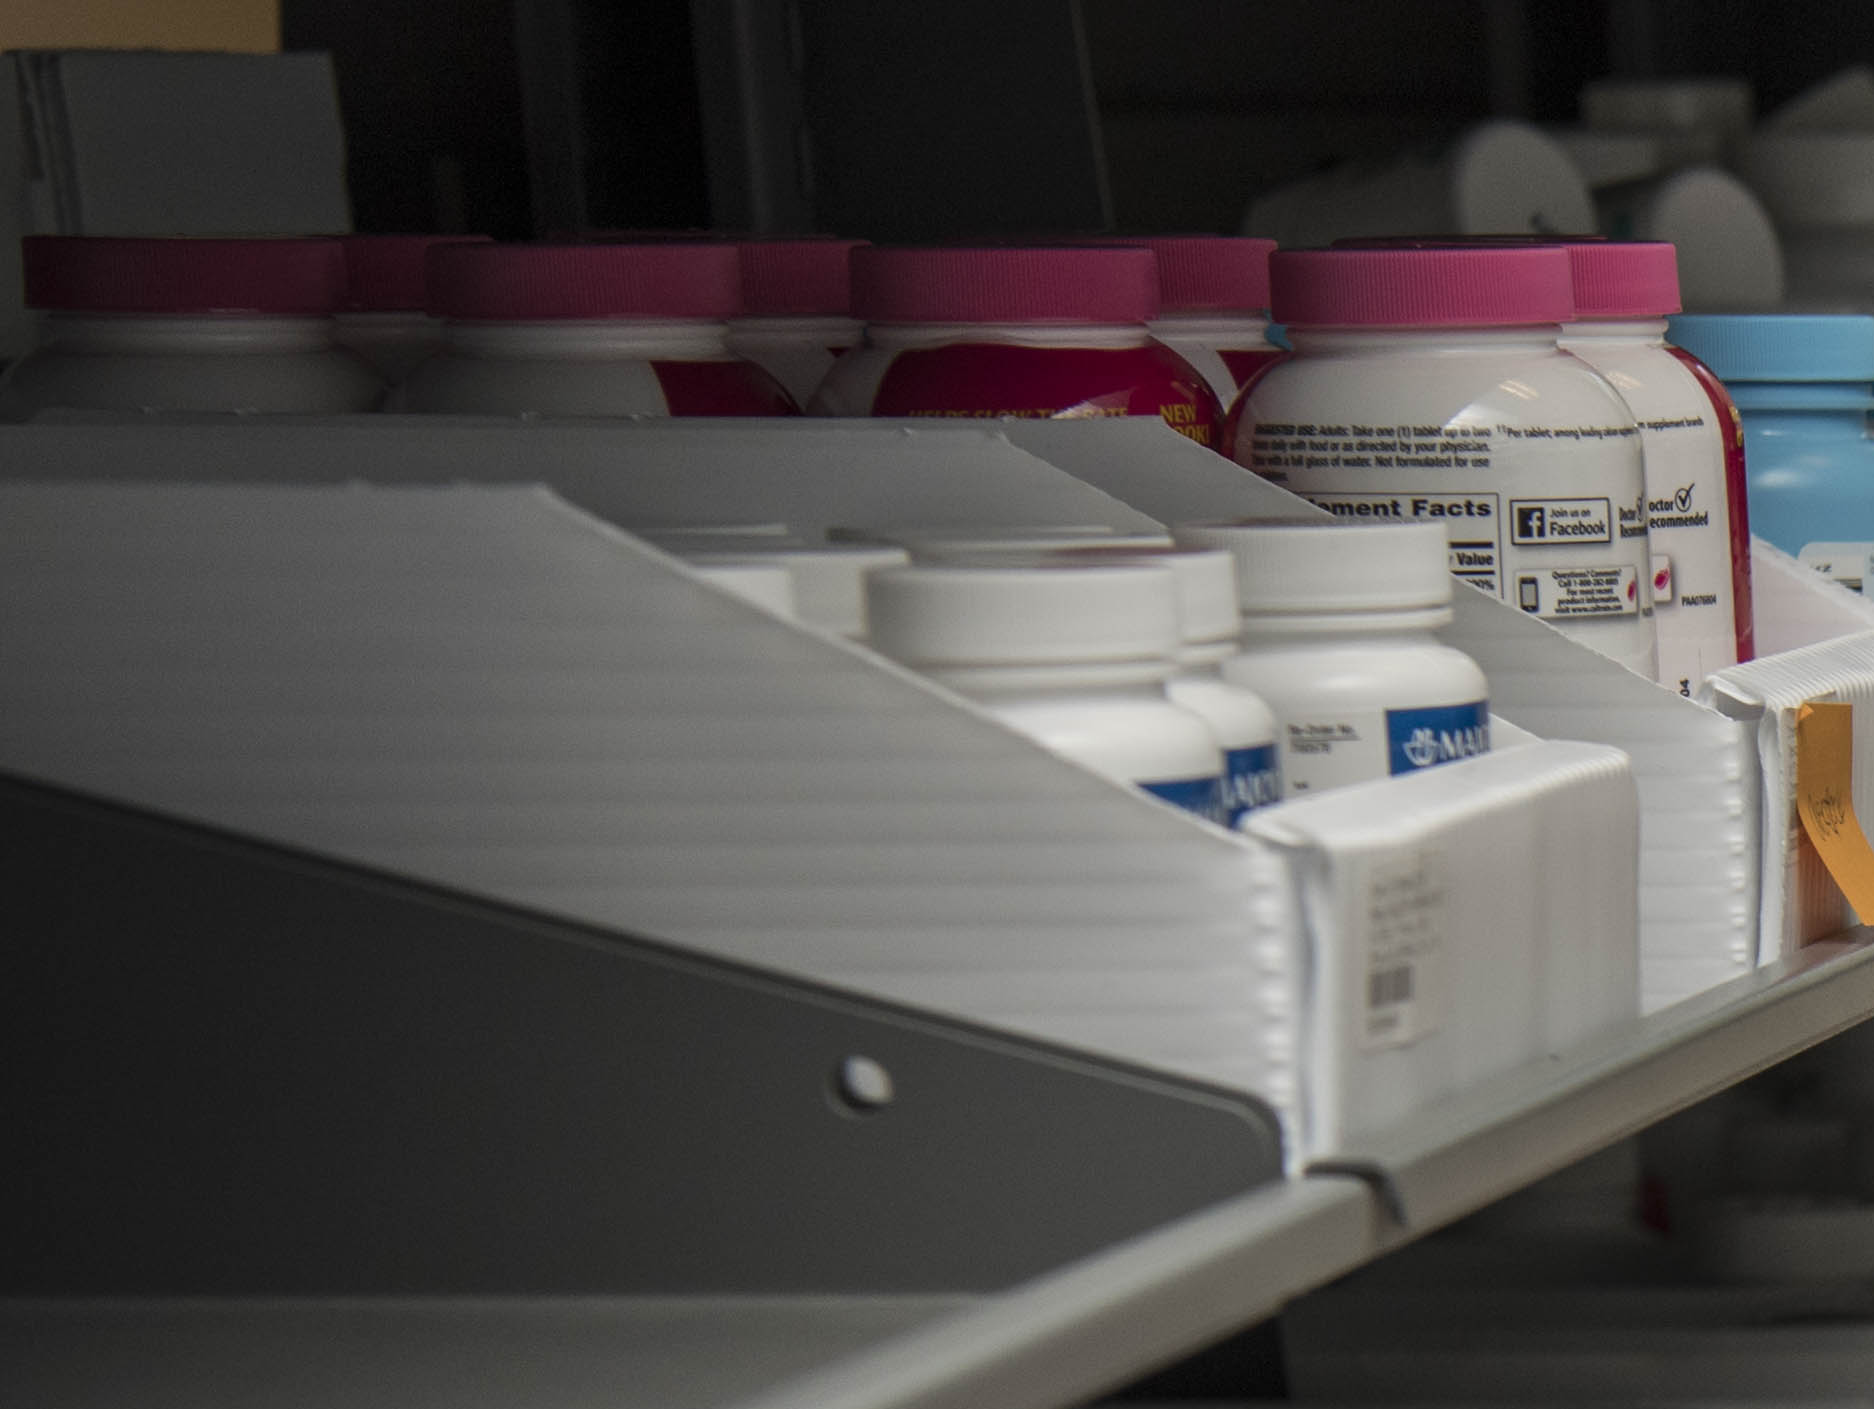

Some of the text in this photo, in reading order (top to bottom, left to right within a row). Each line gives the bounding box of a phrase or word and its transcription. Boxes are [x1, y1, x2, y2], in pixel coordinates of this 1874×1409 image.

[1160, 404, 1196, 423] NEW
[1309, 498, 1492, 517] ement Facts
[1550, 507, 1591, 519] Join us on
[1551, 520, 1606, 537] Facebook
[1650, 511, 1709, 529] ecommended
[1456, 553, 1494, 566] Value
